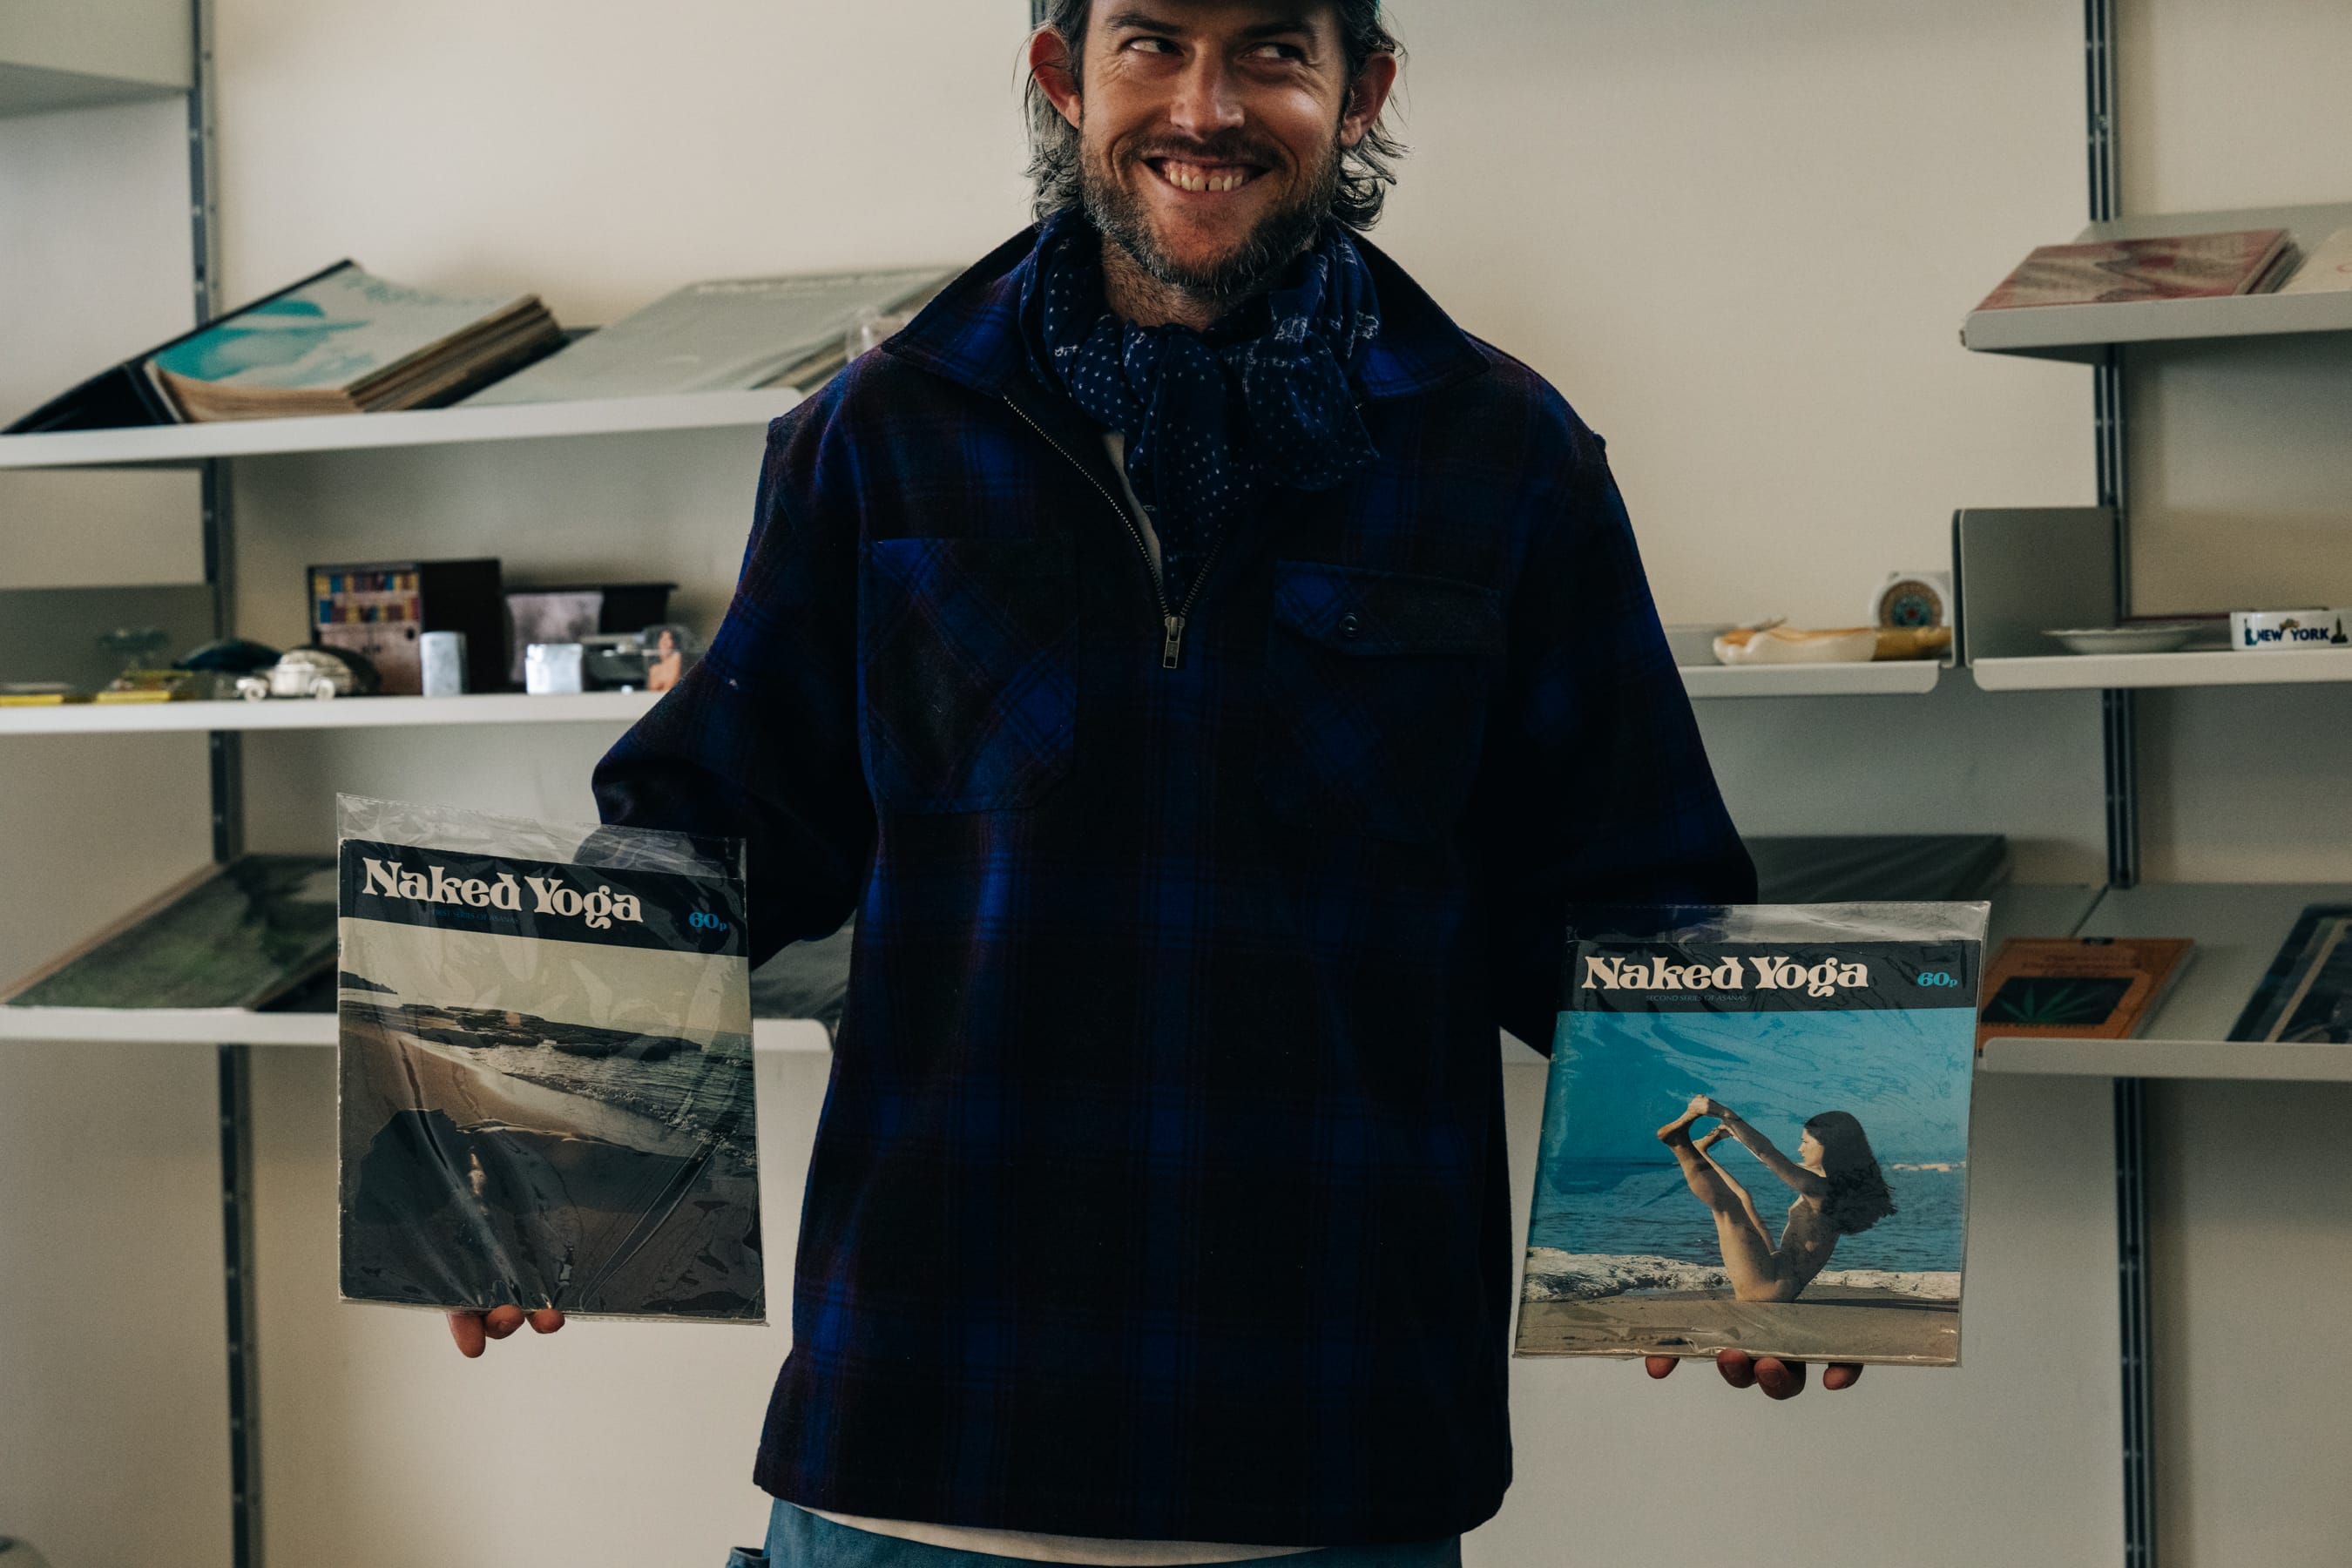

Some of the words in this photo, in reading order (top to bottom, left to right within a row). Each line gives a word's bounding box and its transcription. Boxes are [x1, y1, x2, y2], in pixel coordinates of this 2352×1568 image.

[2257, 628, 2282, 641] NEW
[2290, 627, 2329, 641] YORK
[362, 856, 522, 911] Naked
[524, 876, 644, 929] Yoga
[688, 911, 727, 932] 60p
[1581, 956, 1743, 990] Naked
[1749, 956, 1869, 997] Yoga
[1917, 971, 1957, 989] 60p
